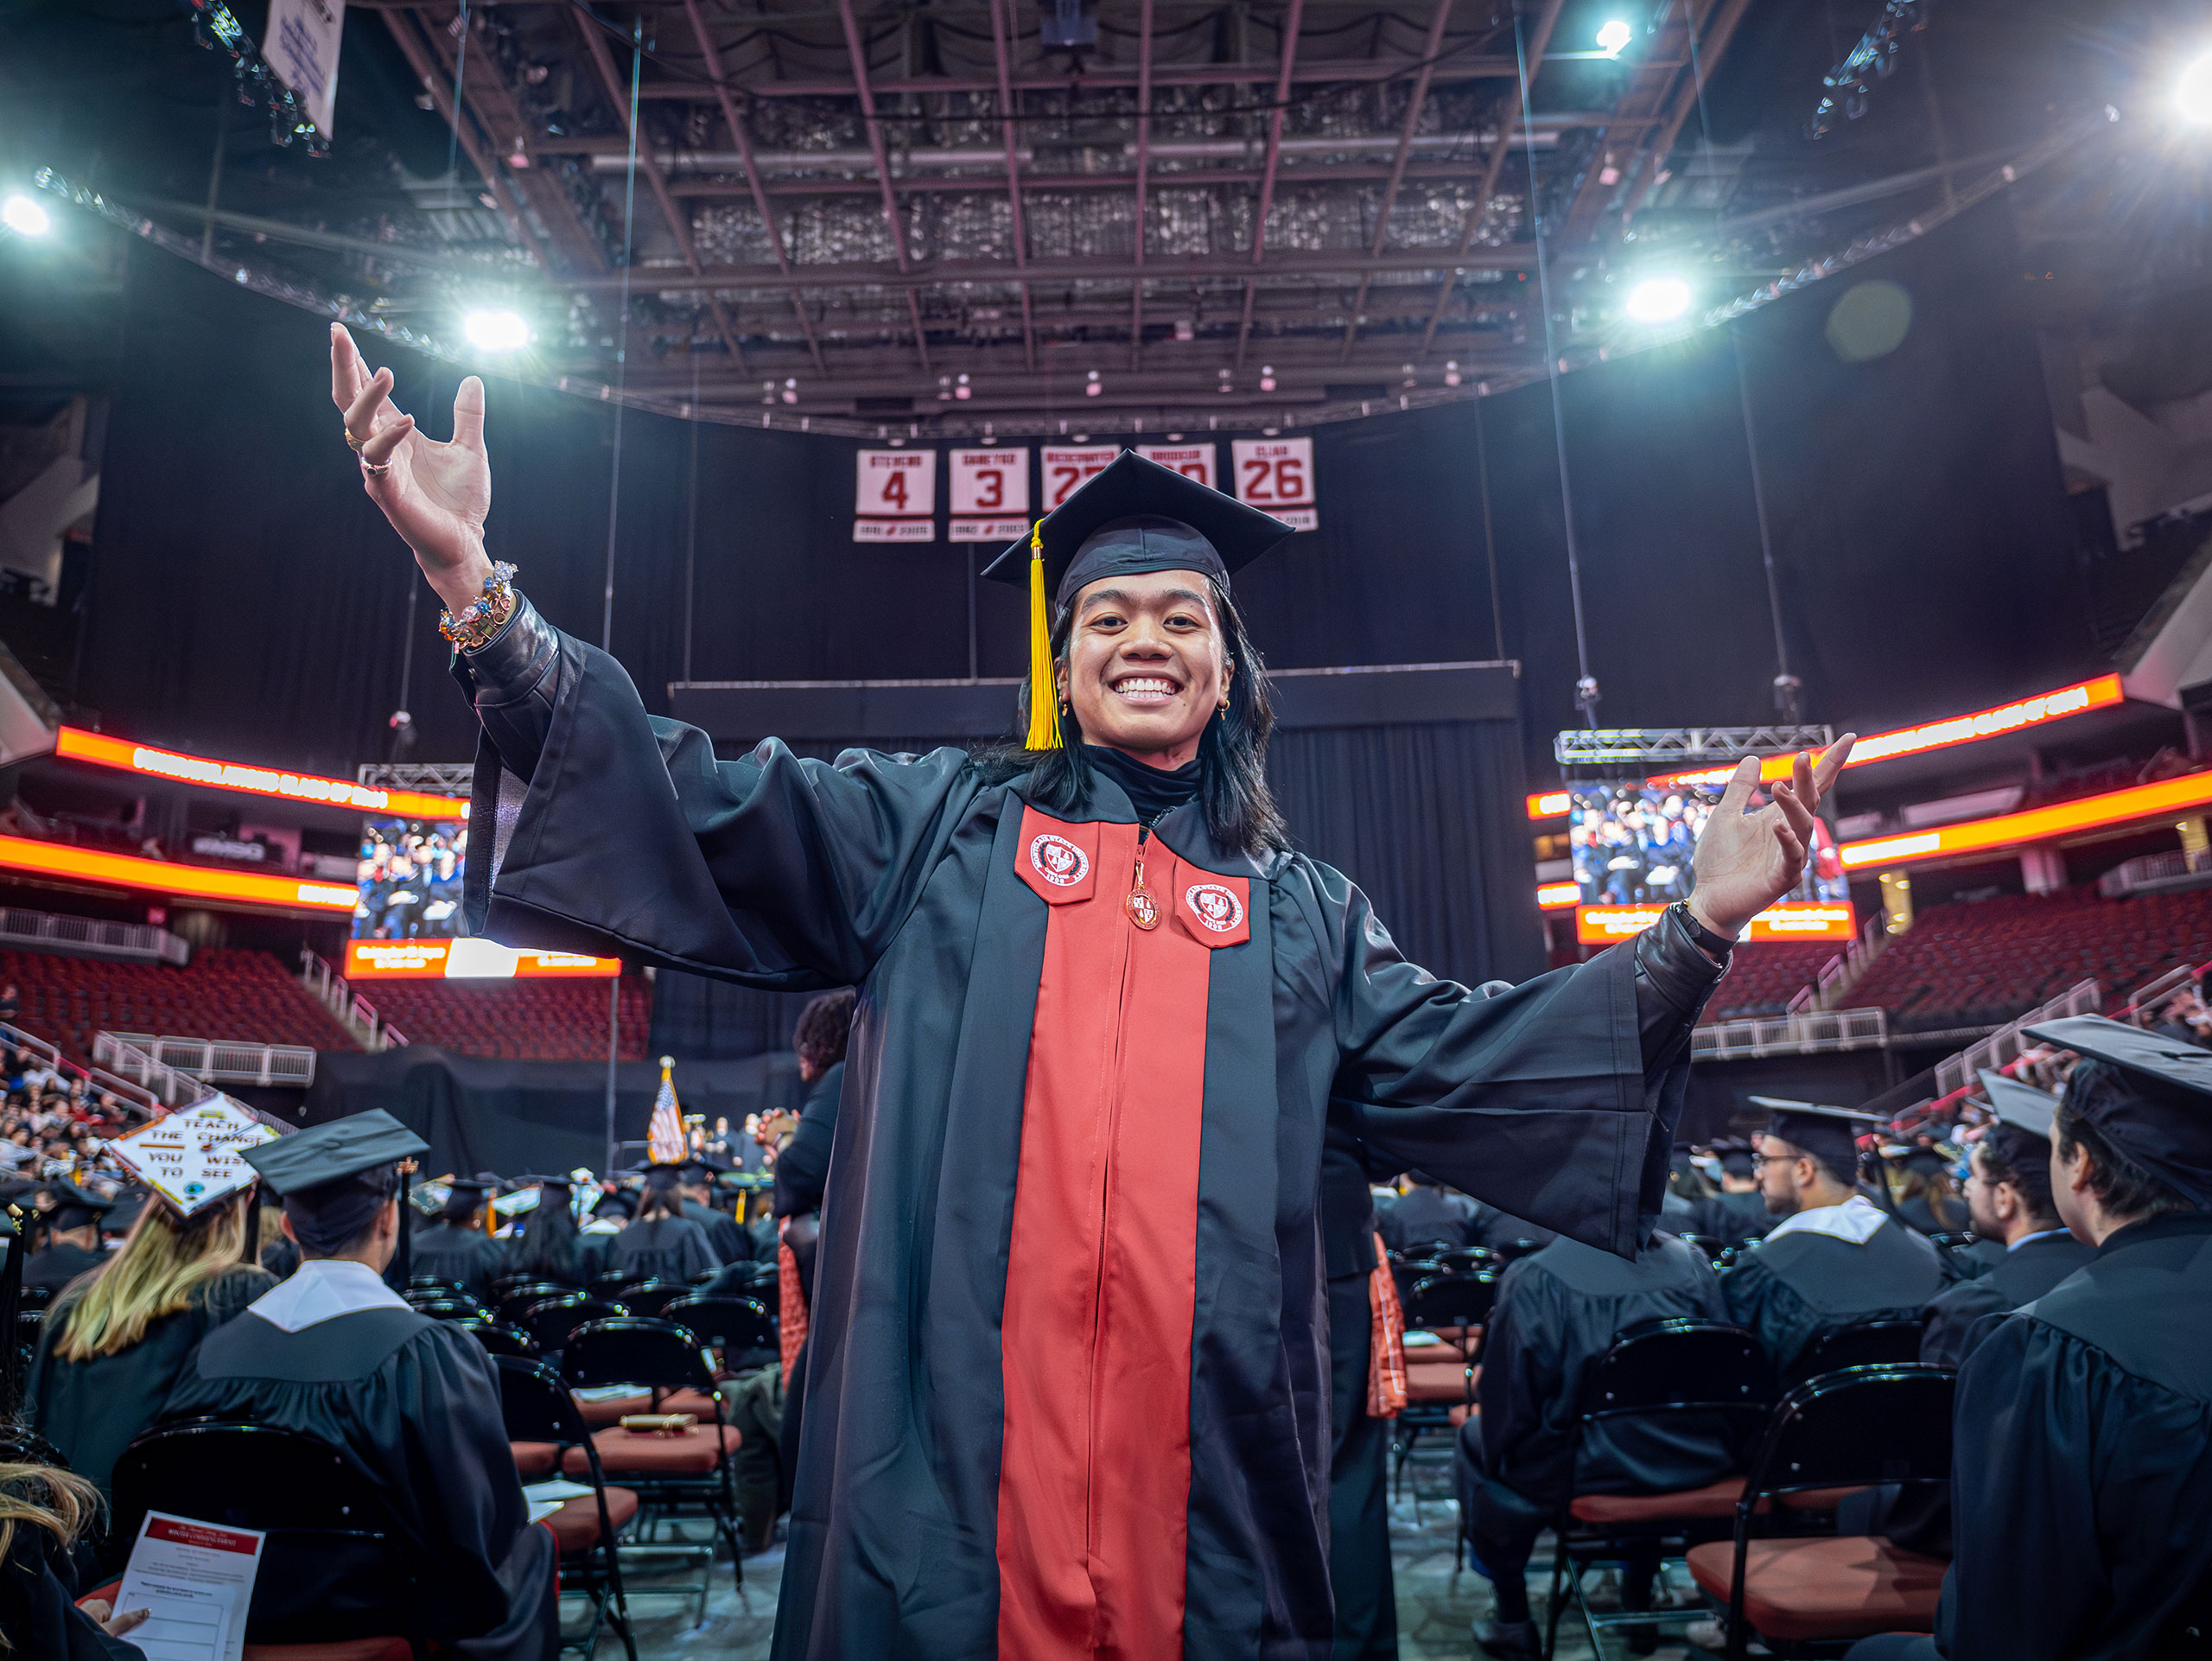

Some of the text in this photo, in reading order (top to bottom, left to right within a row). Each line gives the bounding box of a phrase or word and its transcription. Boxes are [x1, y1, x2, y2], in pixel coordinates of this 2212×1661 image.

[1243, 459, 1302, 499] 26
[882, 471, 908, 510] 4
[976, 470, 1002, 507] 3
[1053, 467, 1105, 506] 2
[1046, 875, 1065, 884] 1908
[1205, 920, 1223, 930] 1908
[184, 1119, 239, 1130] TEACH
[149, 1130, 183, 1140] THE
[149, 1152, 247, 1165] YOU WIS
[160, 1167, 232, 1178] TO SEE
